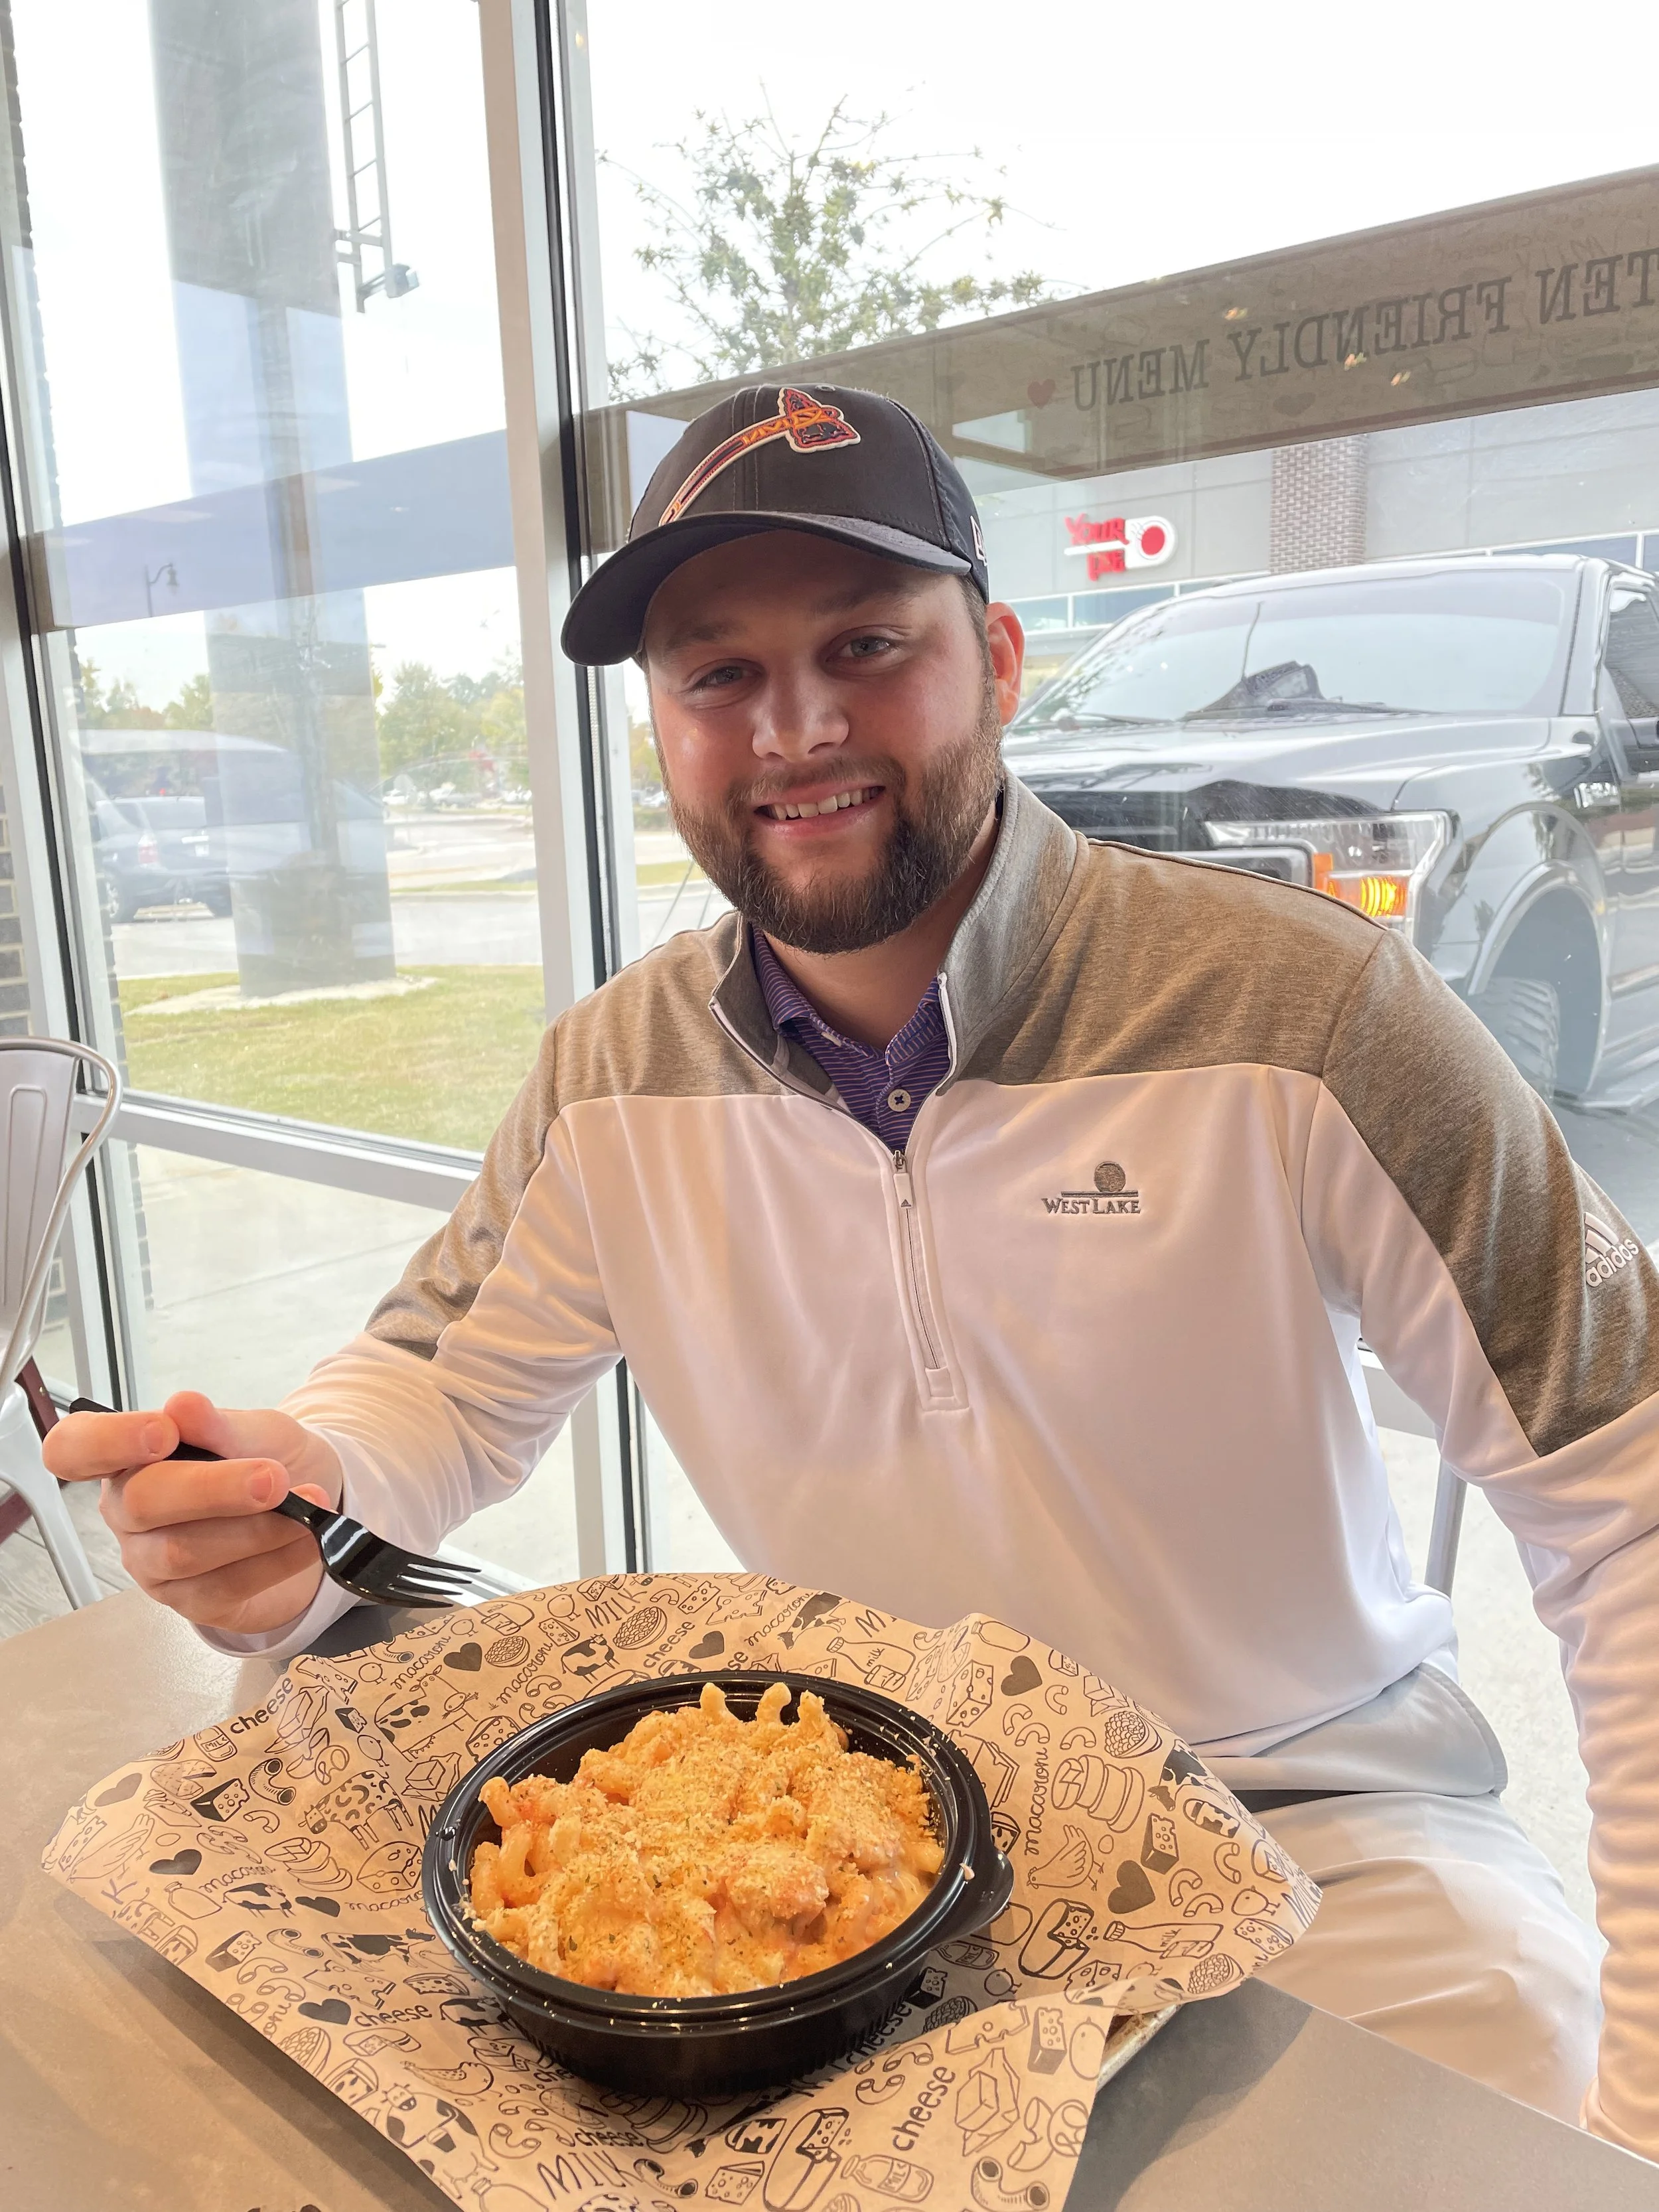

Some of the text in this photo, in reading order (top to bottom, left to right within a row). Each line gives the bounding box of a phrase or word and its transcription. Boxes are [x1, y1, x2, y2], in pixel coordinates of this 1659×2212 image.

[1586, 1238, 1638, 1287] adidas
[487, 1603, 508, 1614] milk
[585, 1588, 647, 1629] MILK
[391, 1636, 451, 1689] macaroni
[644, 1622, 695, 1668] cheese
[496, 1643, 553, 1704] macaroni
[230, 1678, 293, 1733] cheese
[1025, 1747, 1049, 1856] macaroni
[354, 2005, 432, 2027] cheese
[891, 2067, 956, 2151] cheese
[575, 2128, 644, 2147] cheese
[537, 2150, 644, 2200] MILK
